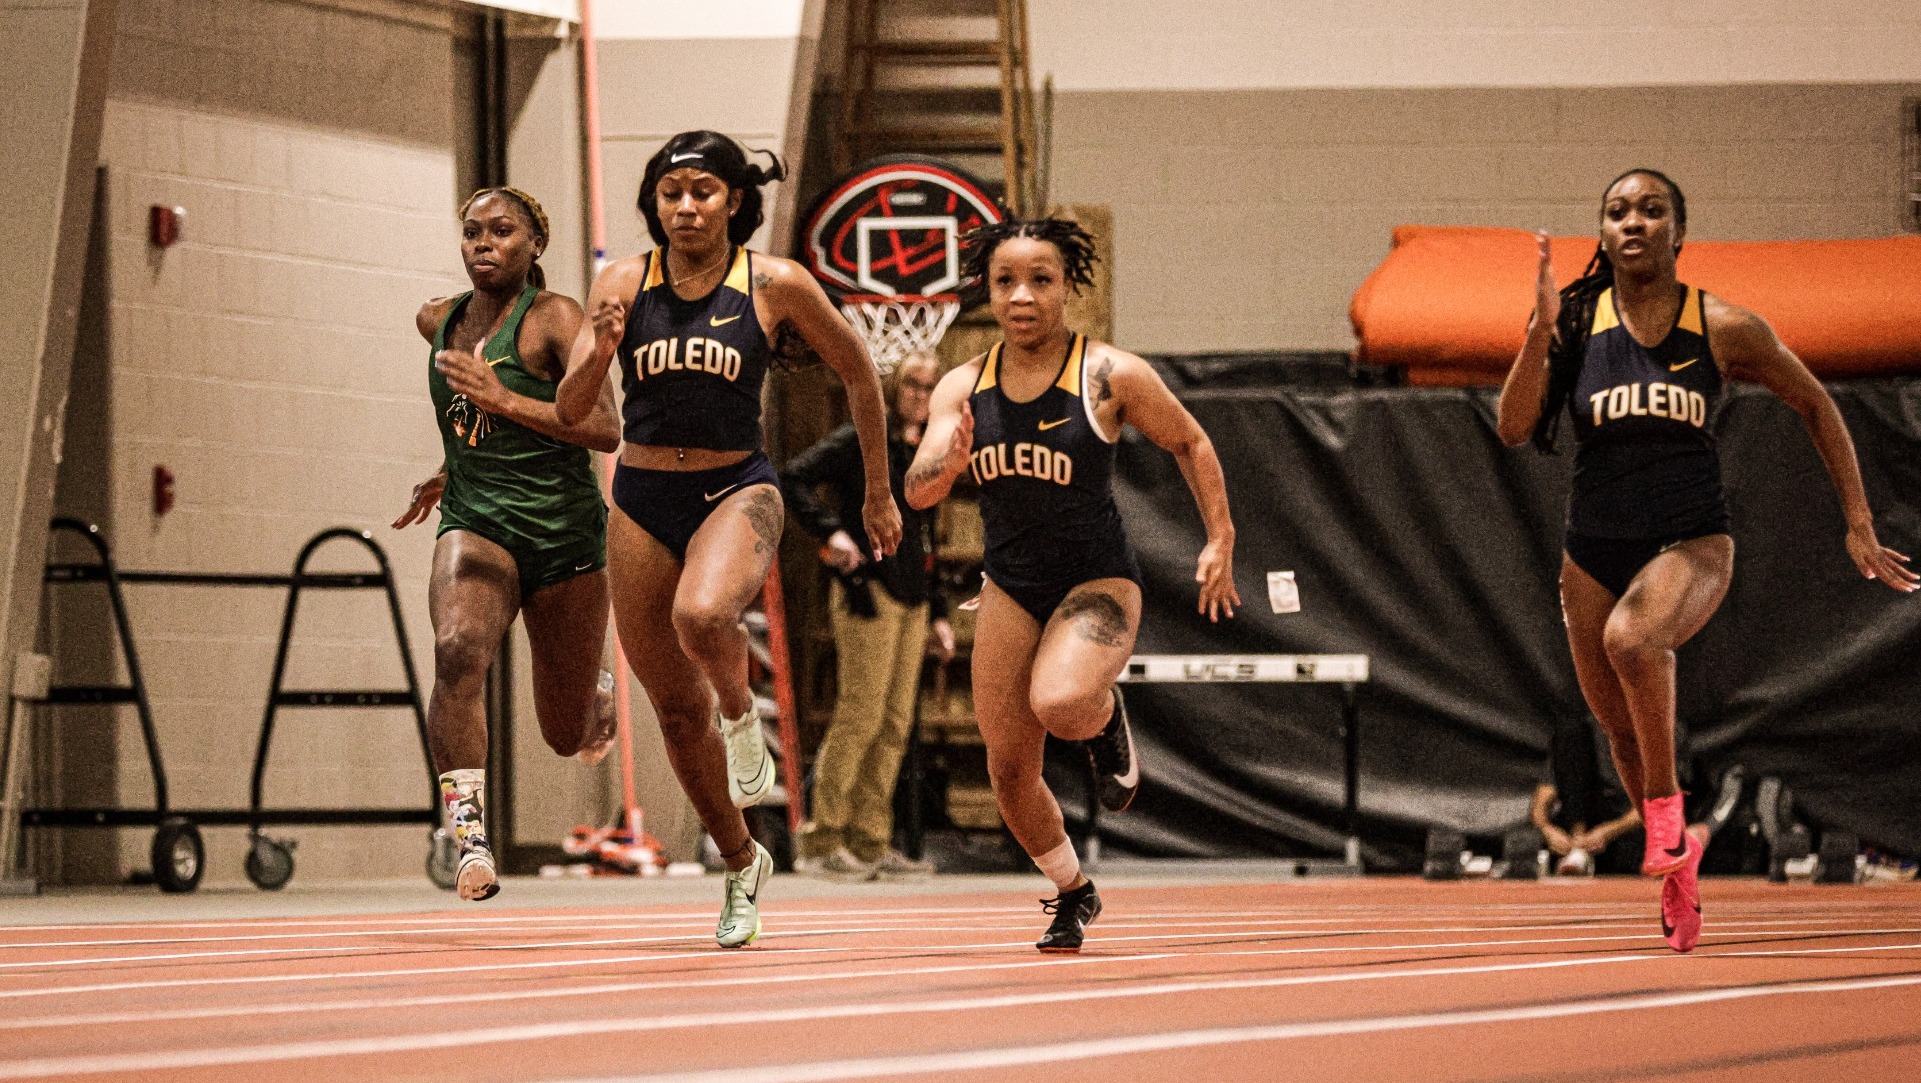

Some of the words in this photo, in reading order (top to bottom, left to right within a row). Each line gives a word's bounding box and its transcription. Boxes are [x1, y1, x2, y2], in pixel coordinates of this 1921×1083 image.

[633, 337, 742, 382] TOLEDO
[1589, 382, 1706, 428] TOLEDO
[970, 442, 1073, 486] TOLEDO
